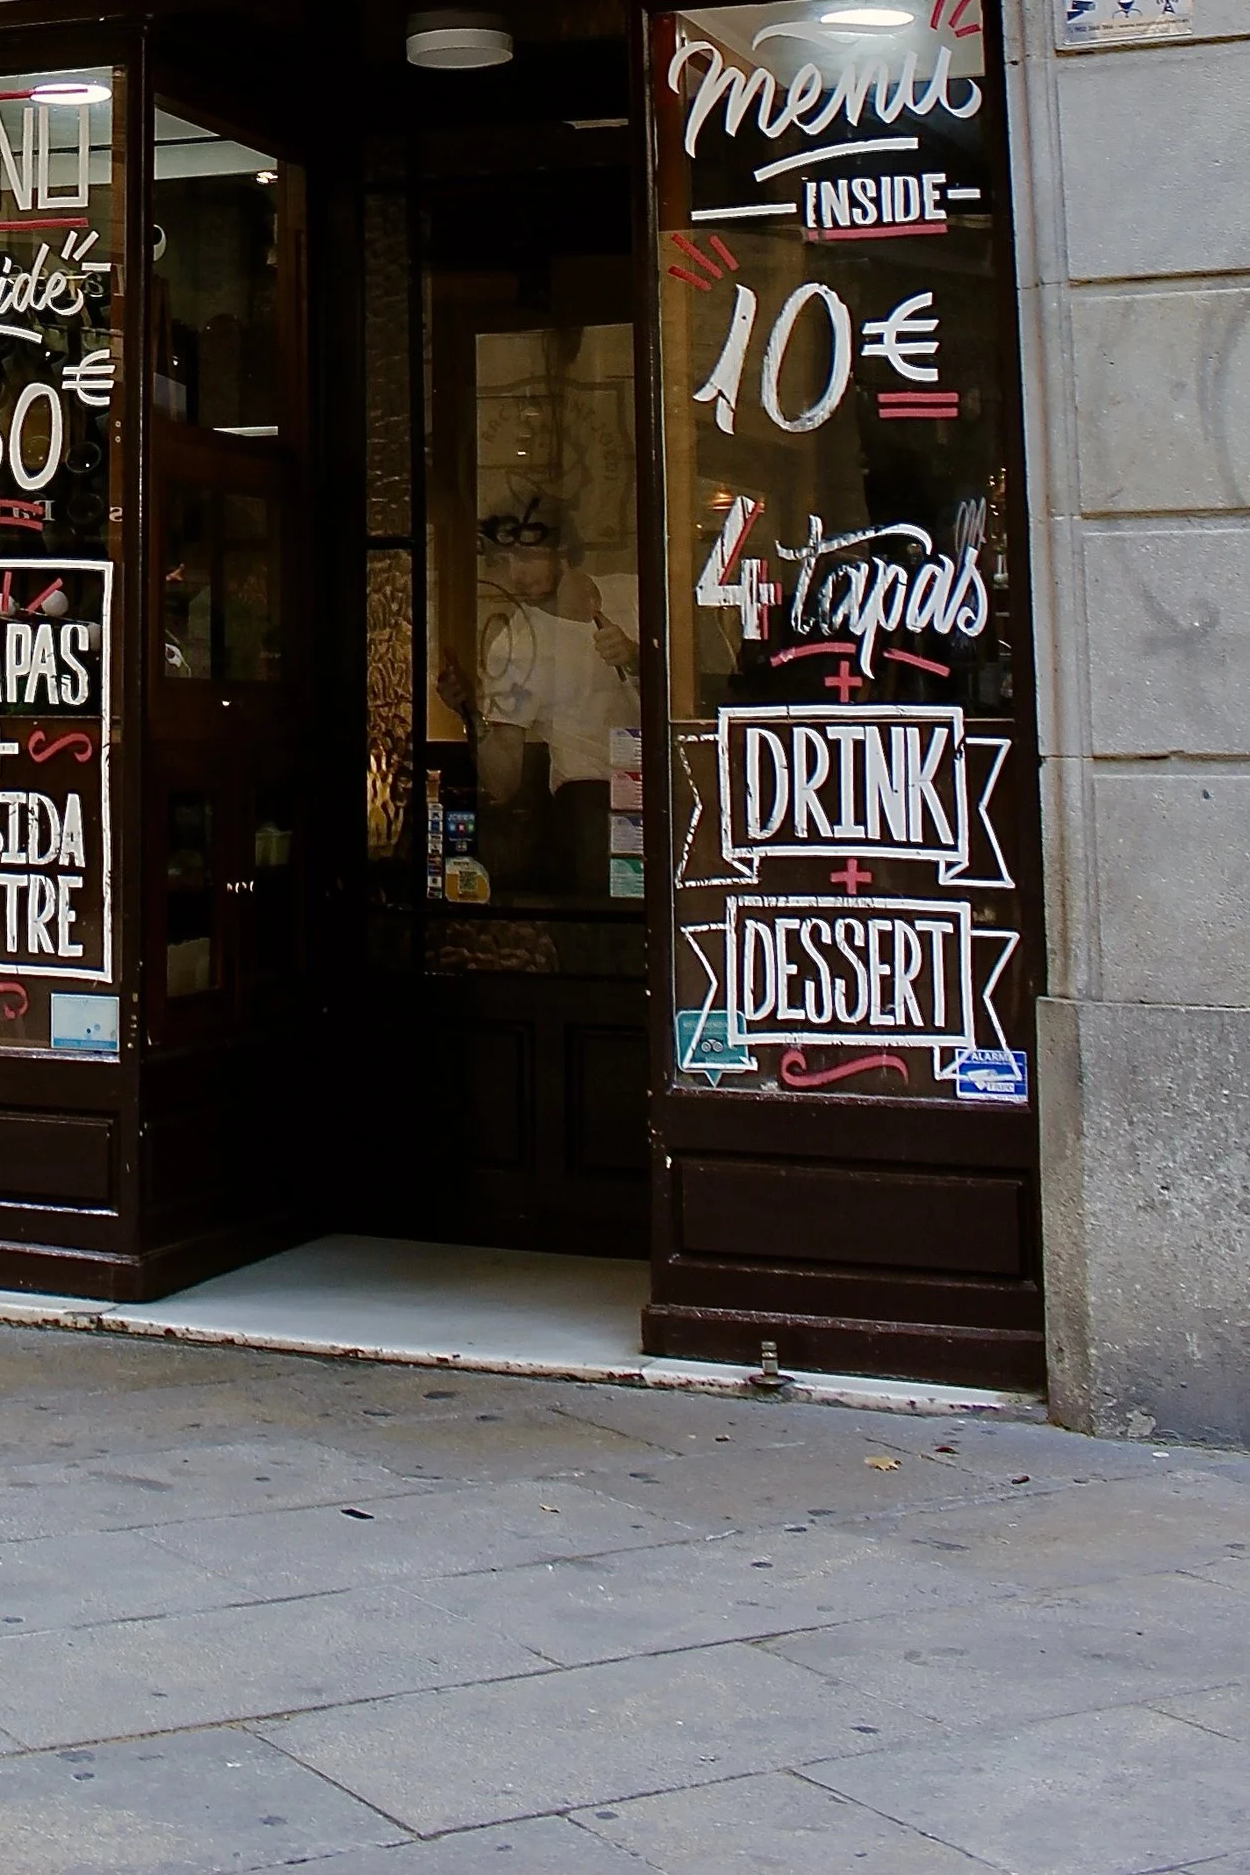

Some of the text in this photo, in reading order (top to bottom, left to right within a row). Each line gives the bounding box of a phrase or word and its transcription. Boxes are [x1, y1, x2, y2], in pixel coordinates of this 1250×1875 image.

[807, 173, 947, 228] INSIDE
[695, 495, 775, 642] 4
[746, 725, 954, 845] DRINK
[742, 918, 954, 1027] DESSERT
